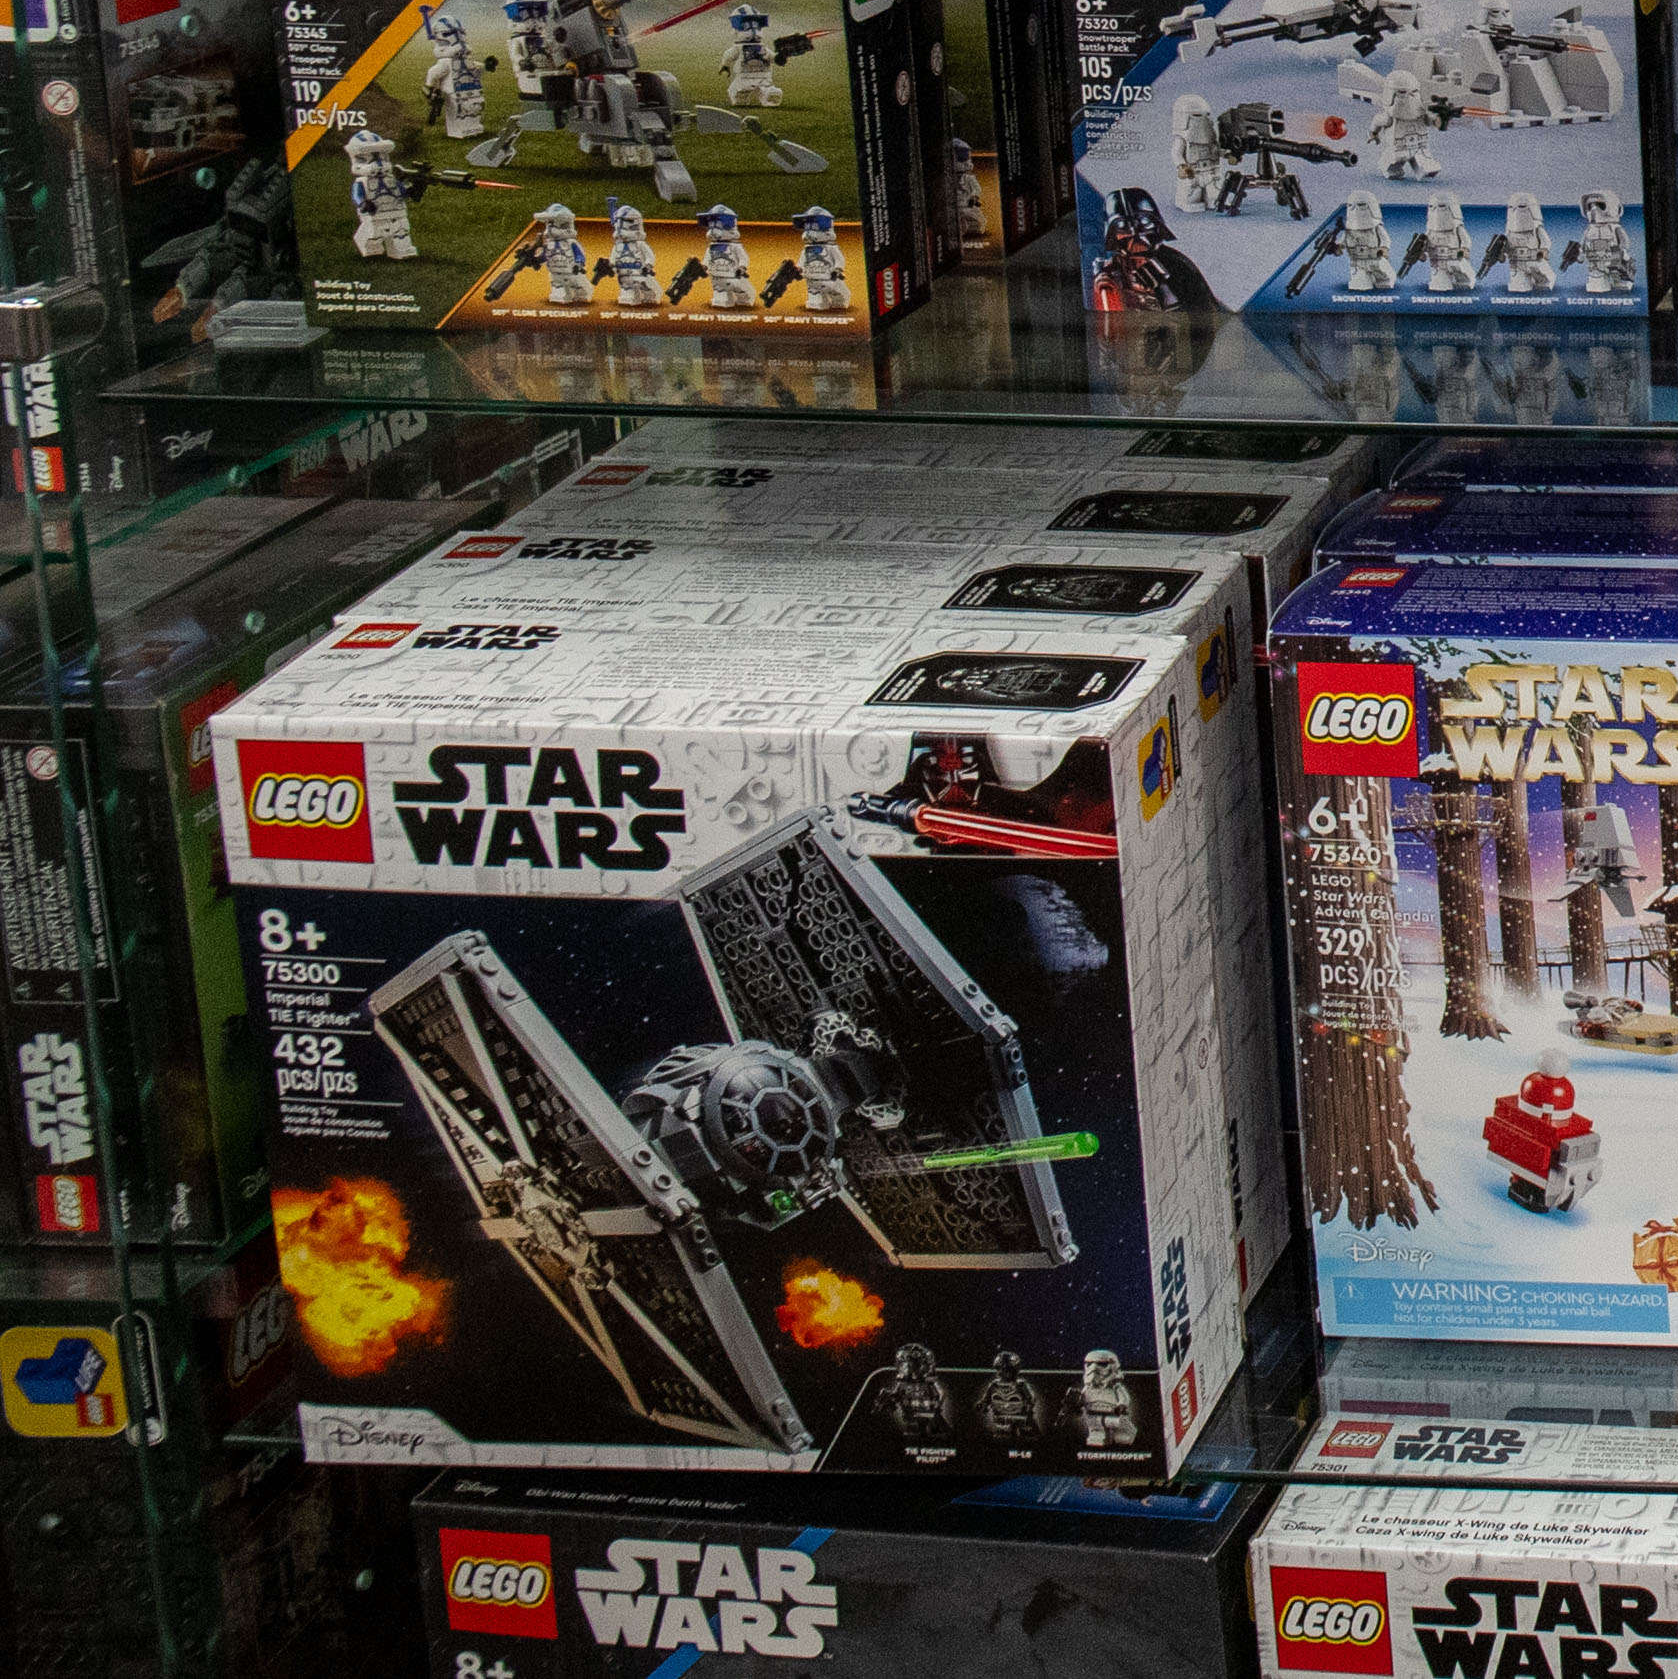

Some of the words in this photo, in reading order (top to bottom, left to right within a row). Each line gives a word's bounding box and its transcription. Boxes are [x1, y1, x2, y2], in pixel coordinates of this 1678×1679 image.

[285, 1, 316, 22] 6+
[1077, 18, 1119, 30] 75320
[286, 27, 328, 39] 75345
[1079, 56, 1112, 78] 105
[292, 81, 322, 102] 119
[1082, 78, 1152, 106] pcs/pzs
[296, 102, 367, 130] pcs/pzs
[1312, 698, 1405, 739] LEGO
[394, 743, 685, 809] STAR
[255, 776, 360, 822] LEGO
[1309, 797, 1367, 834] 6+
[396, 809, 687, 871] WARS
[1309, 844, 1382, 864] 75340
[1312, 874, 1352, 886] LEGO
[1313, 890, 1343, 902] Star
[1347, 892, 1386, 905] Wars
[1315, 905, 1365, 918] Advent
[1371, 908, 1435, 921] Calendar
[260, 909, 326, 952] 8+
[1316, 927, 1365, 956] 329
[262, 961, 340, 984] 75300
[1320, 958, 1411, 992] pcs/pzs
[266, 991, 331, 1007] Imperial
[274, 1034, 345, 1066] 432
[277, 1065, 358, 1098] pcs/pzs
[1393, 1282, 1517, 1304] WARNING:
[1521, 1292, 1596, 1305] CHOKING
[1600, 1293, 1667, 1308] HAZARD.
[1332, 1433, 1381, 1448] LEGO
[1398, 1425, 1527, 1446] STAR
[1394, 1443, 1523, 1464] WARS
[453, 1561, 546, 1601] LEGO
[575, 1539, 836, 1605] STAR
[1284, 1601, 1380, 1642] LEGO
[1412, 1578, 1678, 1639] STAR
[577, 1591, 837, 1658] WARS
